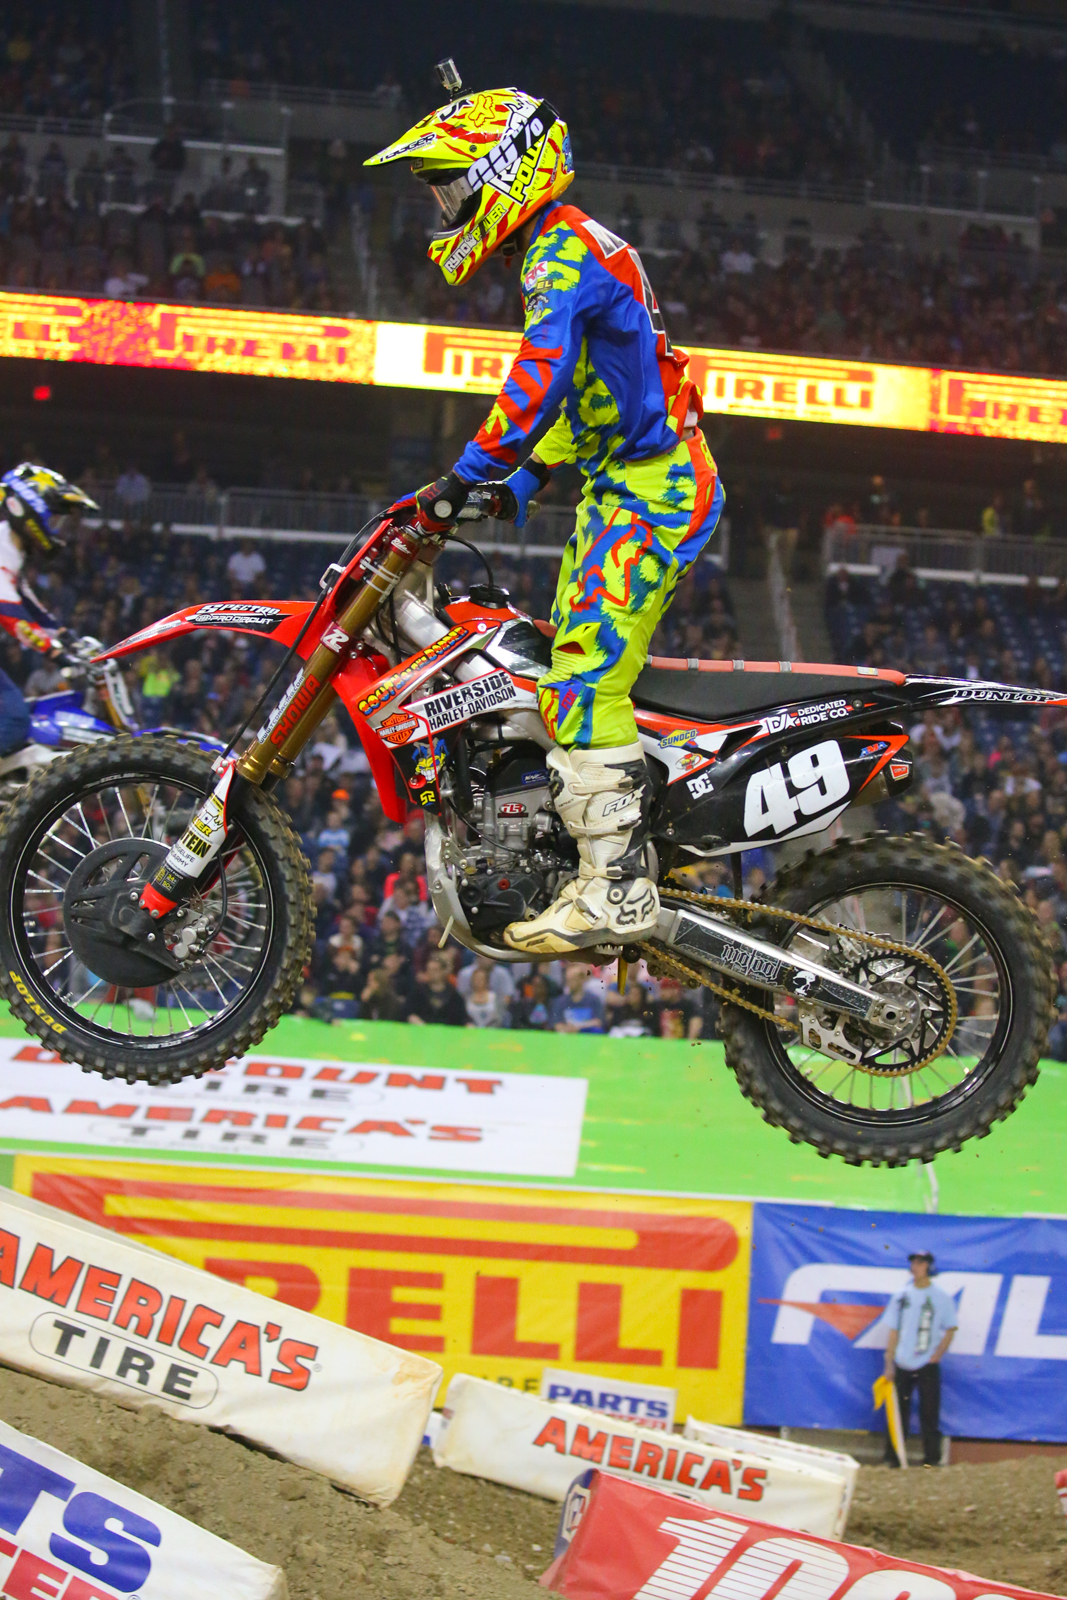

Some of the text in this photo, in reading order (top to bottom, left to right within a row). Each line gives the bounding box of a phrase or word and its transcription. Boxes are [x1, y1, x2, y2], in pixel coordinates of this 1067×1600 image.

[471, 203, 508, 242] PWER
[525, 261, 547, 285] RK
[423, 331, 522, 378] PIR
[195, 604, 281, 617] SPECTRO
[270, 673, 321, 749] SHOWA
[358, 673, 406, 717] SOUTH
[424, 671, 512, 718] RIVERSIDE
[429, 685, 517, 731] HARLEY-DAVIDSON
[561, 687, 578, 711] FOX
[797, 699, 847, 717] DEDICATED
[800, 707, 849, 726] RIDE CO.
[953, 689, 1055, 703] DUNLOP
[661, 730, 697, 747] SUNOCO
[602, 783, 647, 818] FOX
[743, 739, 850, 838] 49
[9, 969, 68, 1035] DUNLOP
[11, 1045, 502, 1096] DOUNT
[0, 1095, 484, 1144] AMERICA'S
[119, 1123, 333, 1151] TIRE
[32, 1172, 739, 1370] PRELLI
[0, 1226, 318, 1392] AMERICA'S
[52, 1319, 200, 1401] TIRE
[547, 1384, 670, 1419] PARTS
[532, 1415, 769, 1503] AMERICA'S
